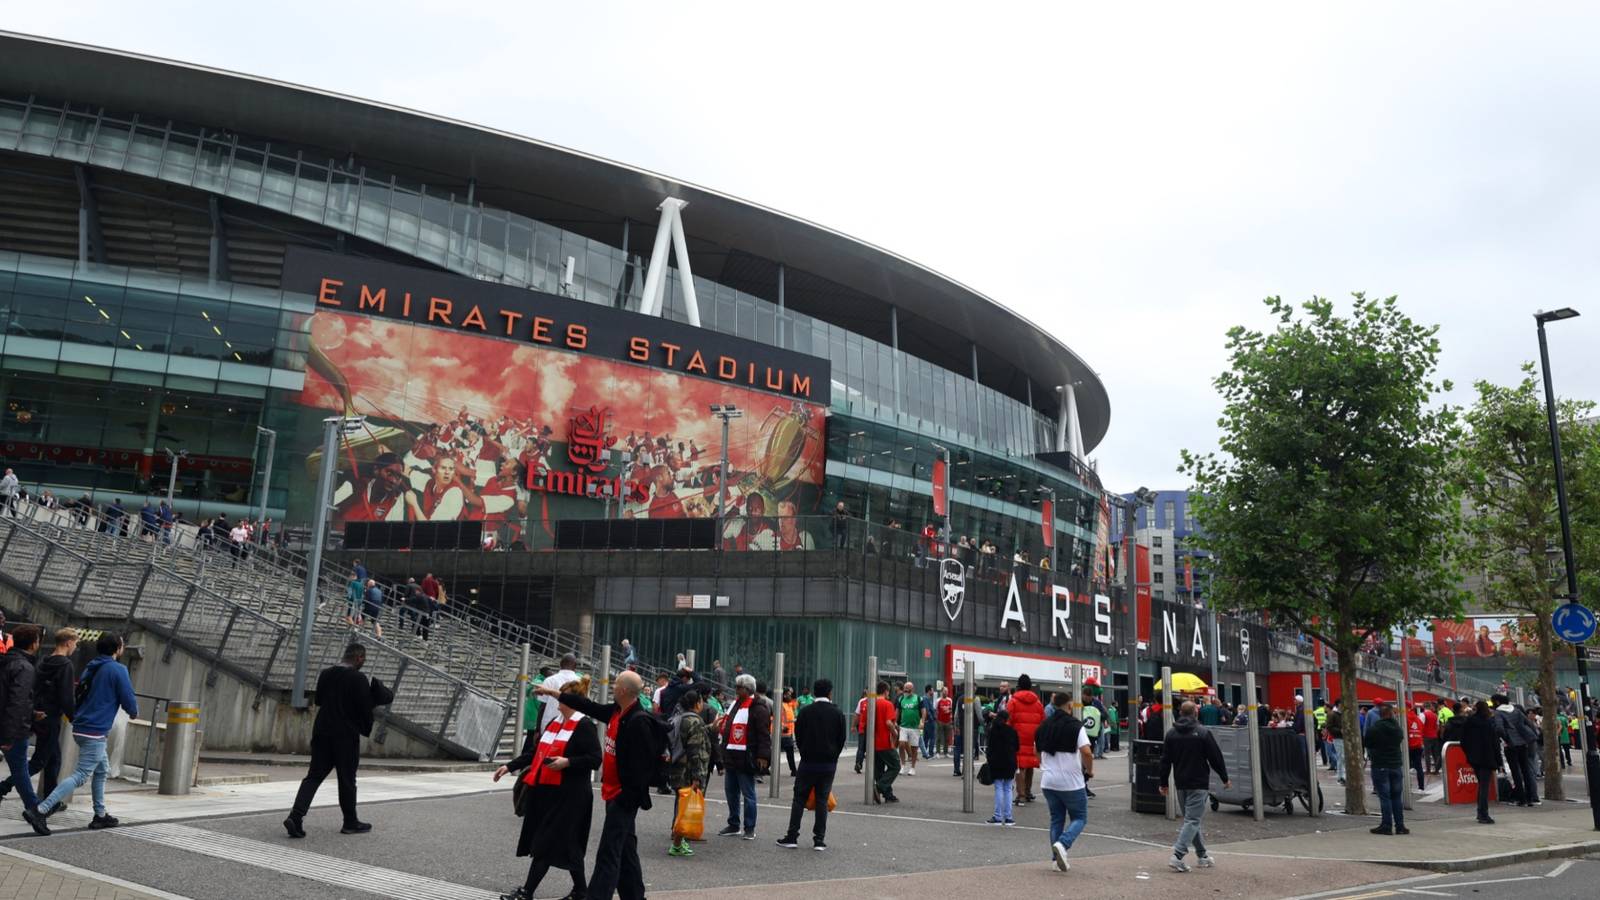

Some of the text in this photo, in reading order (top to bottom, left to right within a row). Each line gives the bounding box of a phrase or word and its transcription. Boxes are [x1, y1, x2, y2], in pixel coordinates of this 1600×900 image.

[319, 278, 810, 397] EMIRATES STADIUM
[1000, 572, 1227, 663] ARSNAL
